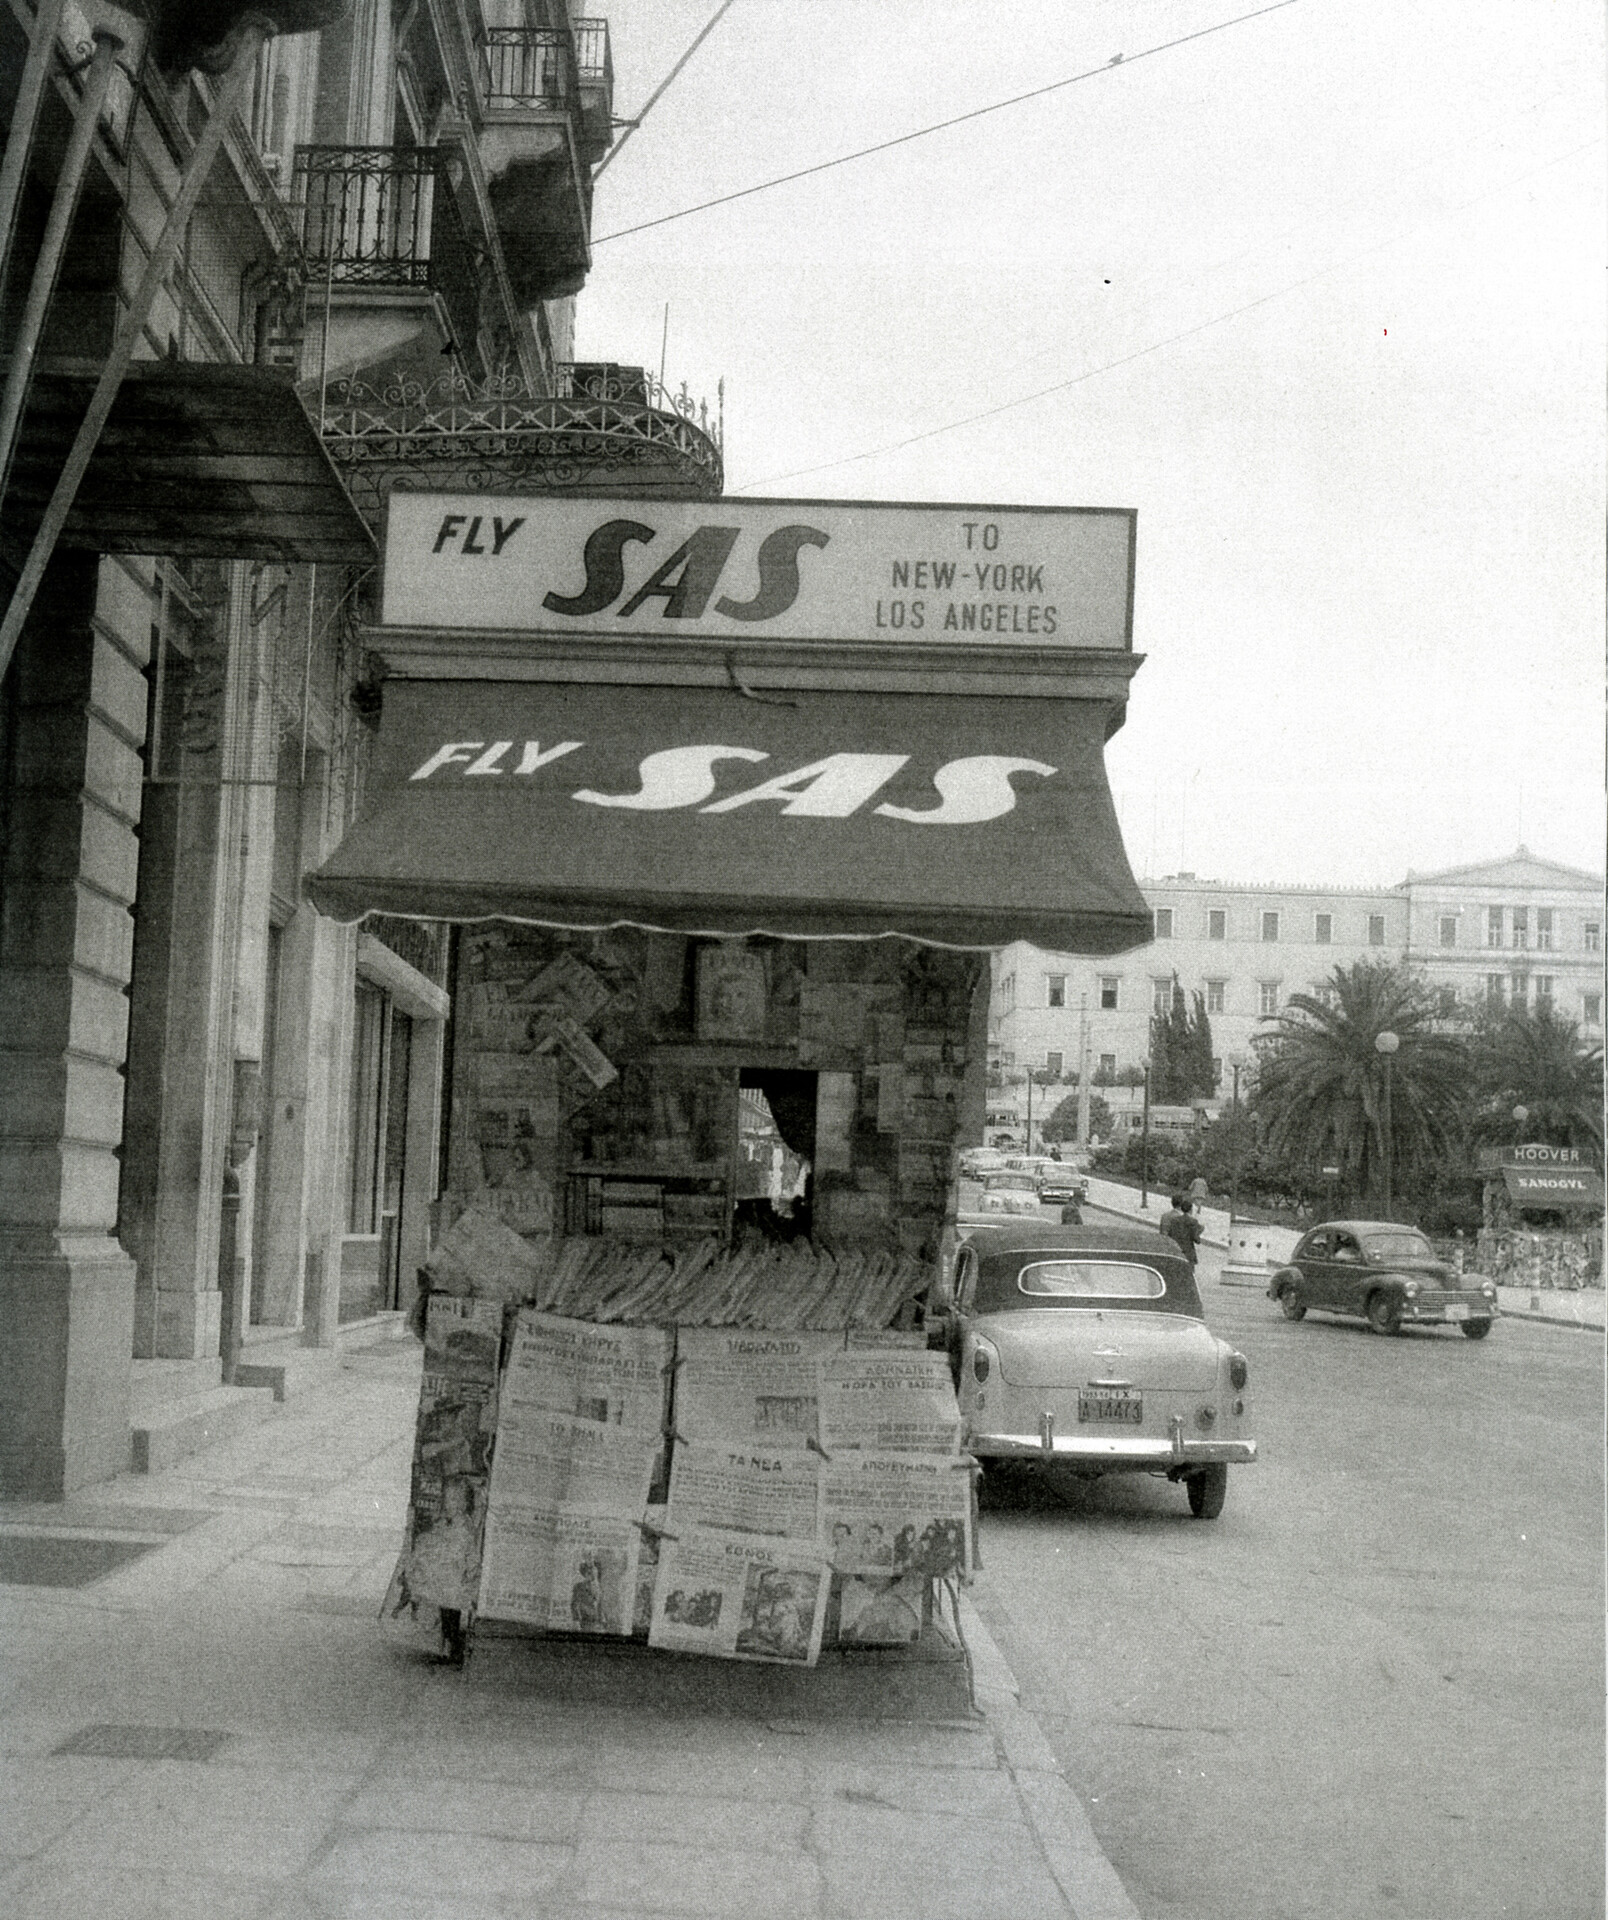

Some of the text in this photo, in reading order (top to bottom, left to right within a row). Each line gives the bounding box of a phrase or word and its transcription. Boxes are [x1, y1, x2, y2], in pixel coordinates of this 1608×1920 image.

[962, 523, 1000, 551] TO
[433, 515, 831, 622] FLY SAS
[891, 561, 1046, 593] NEW-YORK
[875, 601, 1058, 634] LOS ANGELES
[409, 741, 1059, 824] FLY SAS
[1514, 1148, 1580, 1162] HOOVER
[1518, 1177, 1588, 1190] SANOGYL
[728, 1453, 783, 1472] ΤΑ ΝΕΑ
[724, 1543, 774, 1562] ΕΘΝΟΣ
